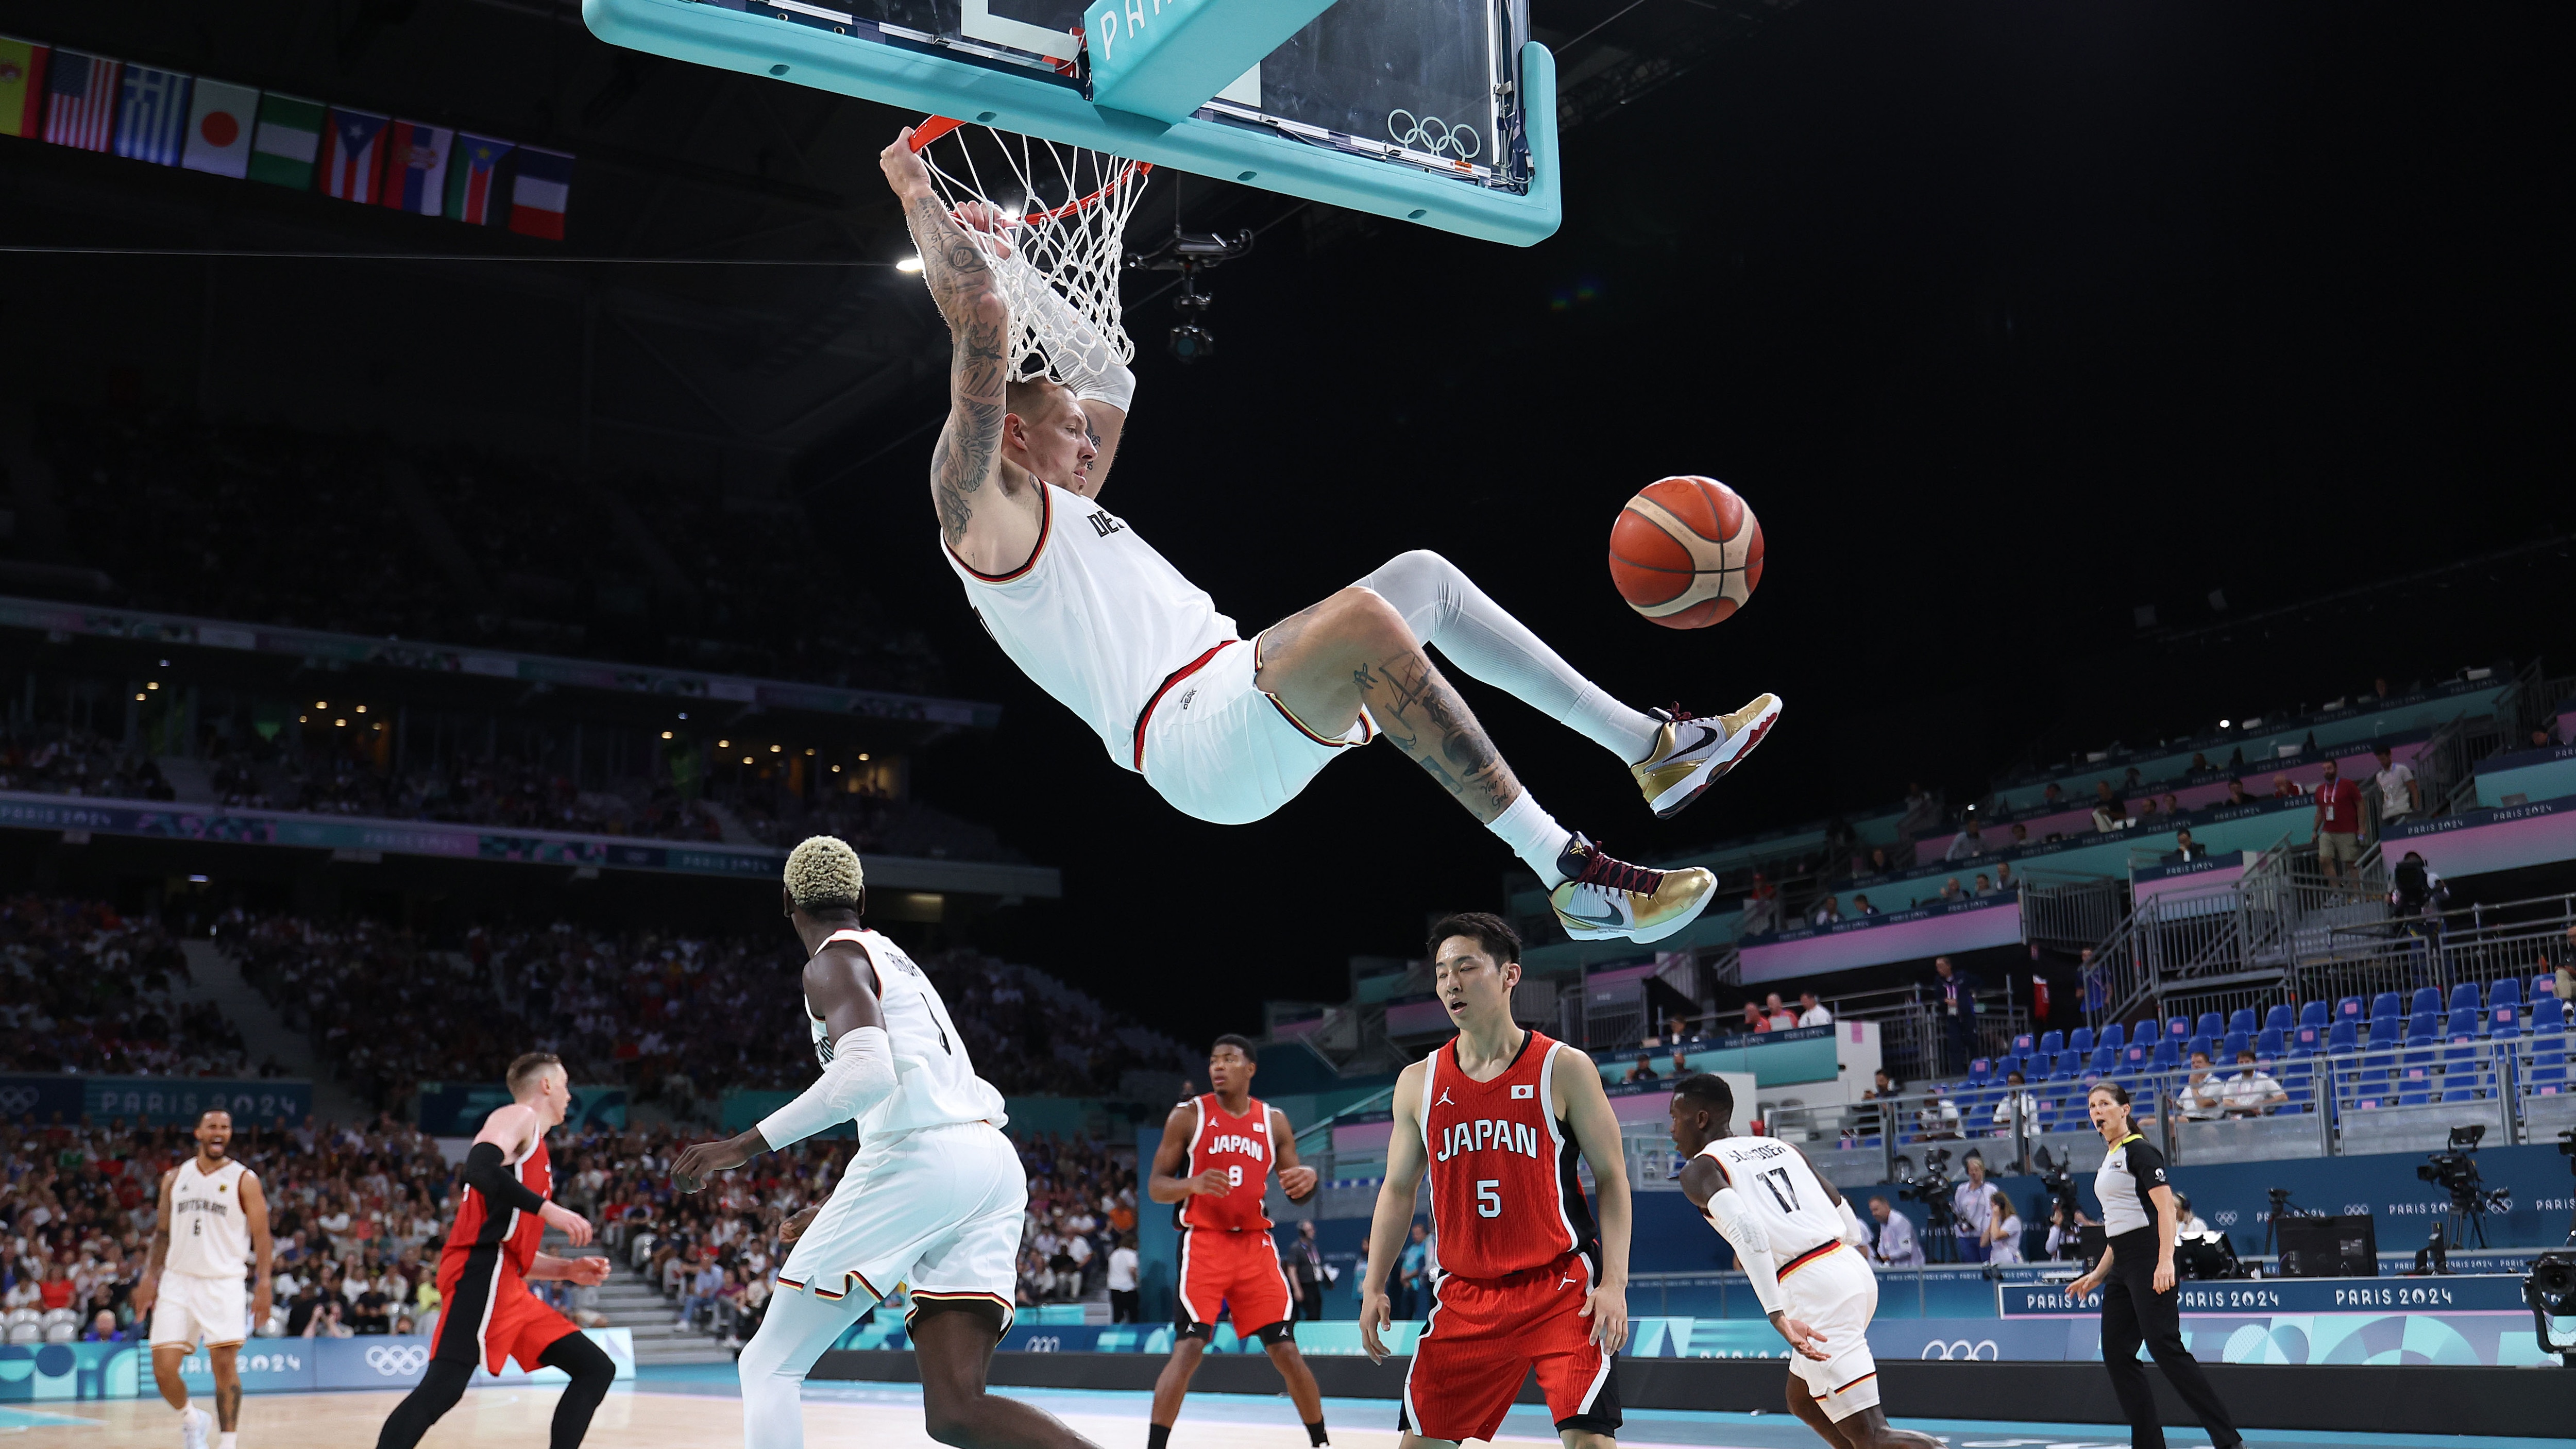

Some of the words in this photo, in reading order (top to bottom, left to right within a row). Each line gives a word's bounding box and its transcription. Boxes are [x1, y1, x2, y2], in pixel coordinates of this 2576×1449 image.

[2493, 809, 2522, 821] PARIS
[2525, 804, 2552, 816] 2024
[2408, 824, 2435, 835] PARIS
[2439, 819, 2463, 831] 2024
[2166, 866, 2189, 875] PARIS
[2192, 862, 2213, 872] 2024
[101, 1091, 198, 1116] PARIS
[1208, 1134, 1264, 1162] JAPAN
[1436, 1119, 1537, 1162] JAPAN
[1476, 1179, 1502, 1218] 5
[1755, 1167, 1801, 1215] 17
[2389, 1203, 2426, 1216] PARIS
[2470, 1260, 2493, 1269] 2024
[2027, 1293, 2072, 1309] PARIS
[2230, 1290, 2279, 1307] 2024
[2335, 1289, 2393, 1306] PARIS
[2398, 1288, 2453, 1305] 2024
[236, 1353, 301, 1373] 2024
